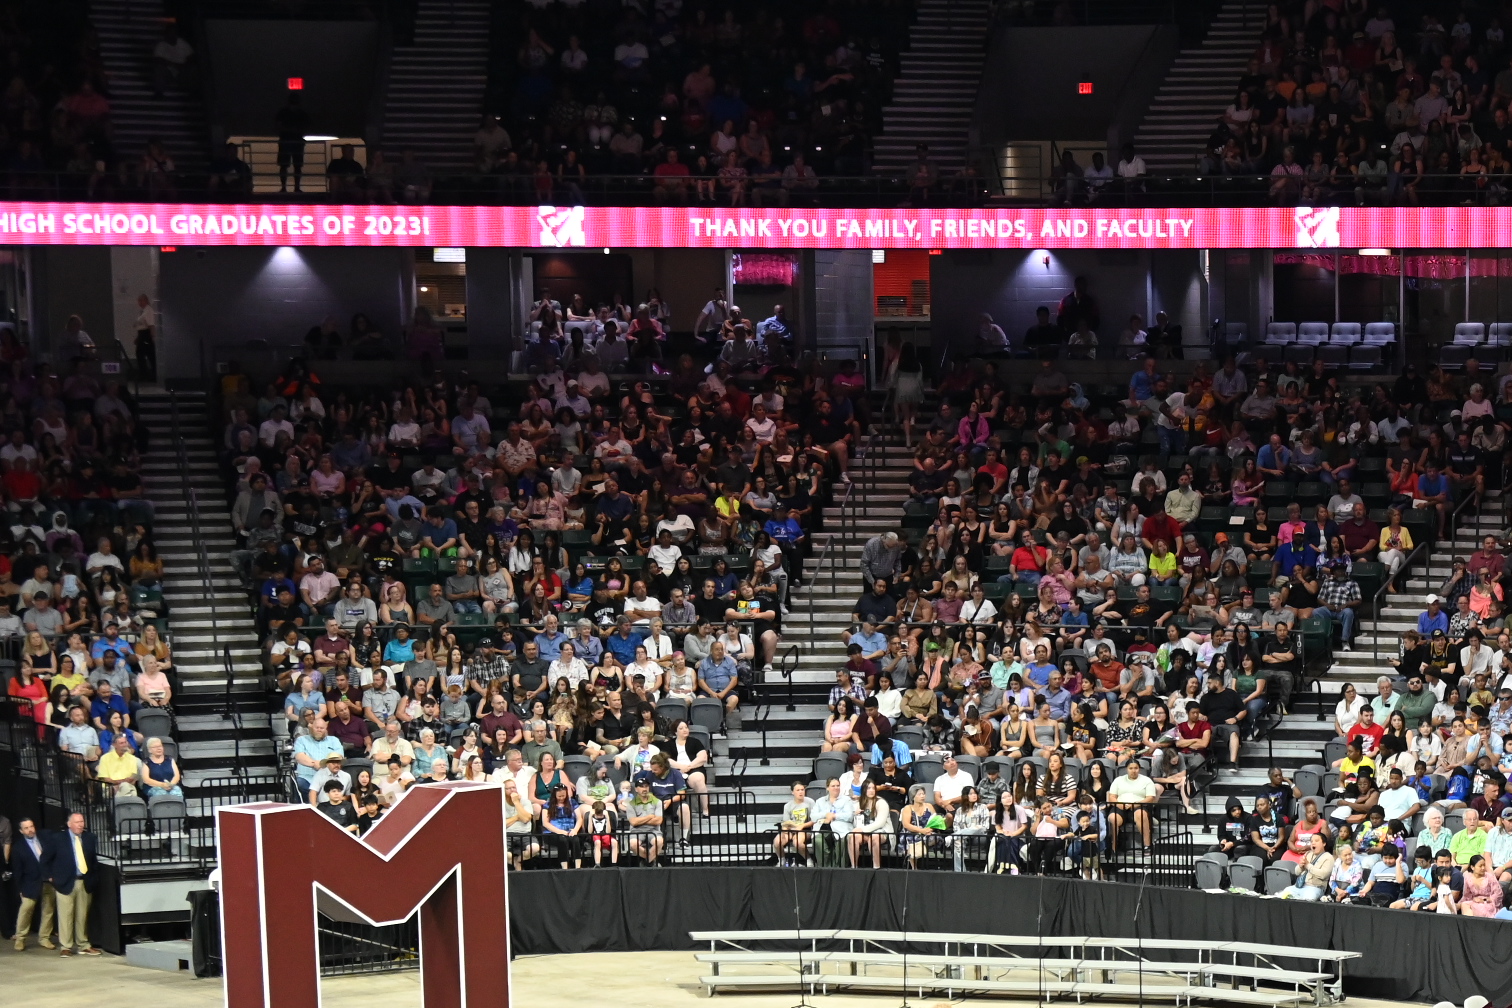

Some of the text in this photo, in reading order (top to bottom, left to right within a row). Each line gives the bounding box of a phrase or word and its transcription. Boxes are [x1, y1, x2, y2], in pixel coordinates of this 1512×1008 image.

[63, 213, 164, 234] SCHOOL
[170, 214, 315, 235] GRADUATES
[323, 215, 355, 235] OF
[364, 216, 430, 235] 2023!
[690, 218, 1193, 241] THANK YOU FAMILY, FRIENDS, AND FACULTY
